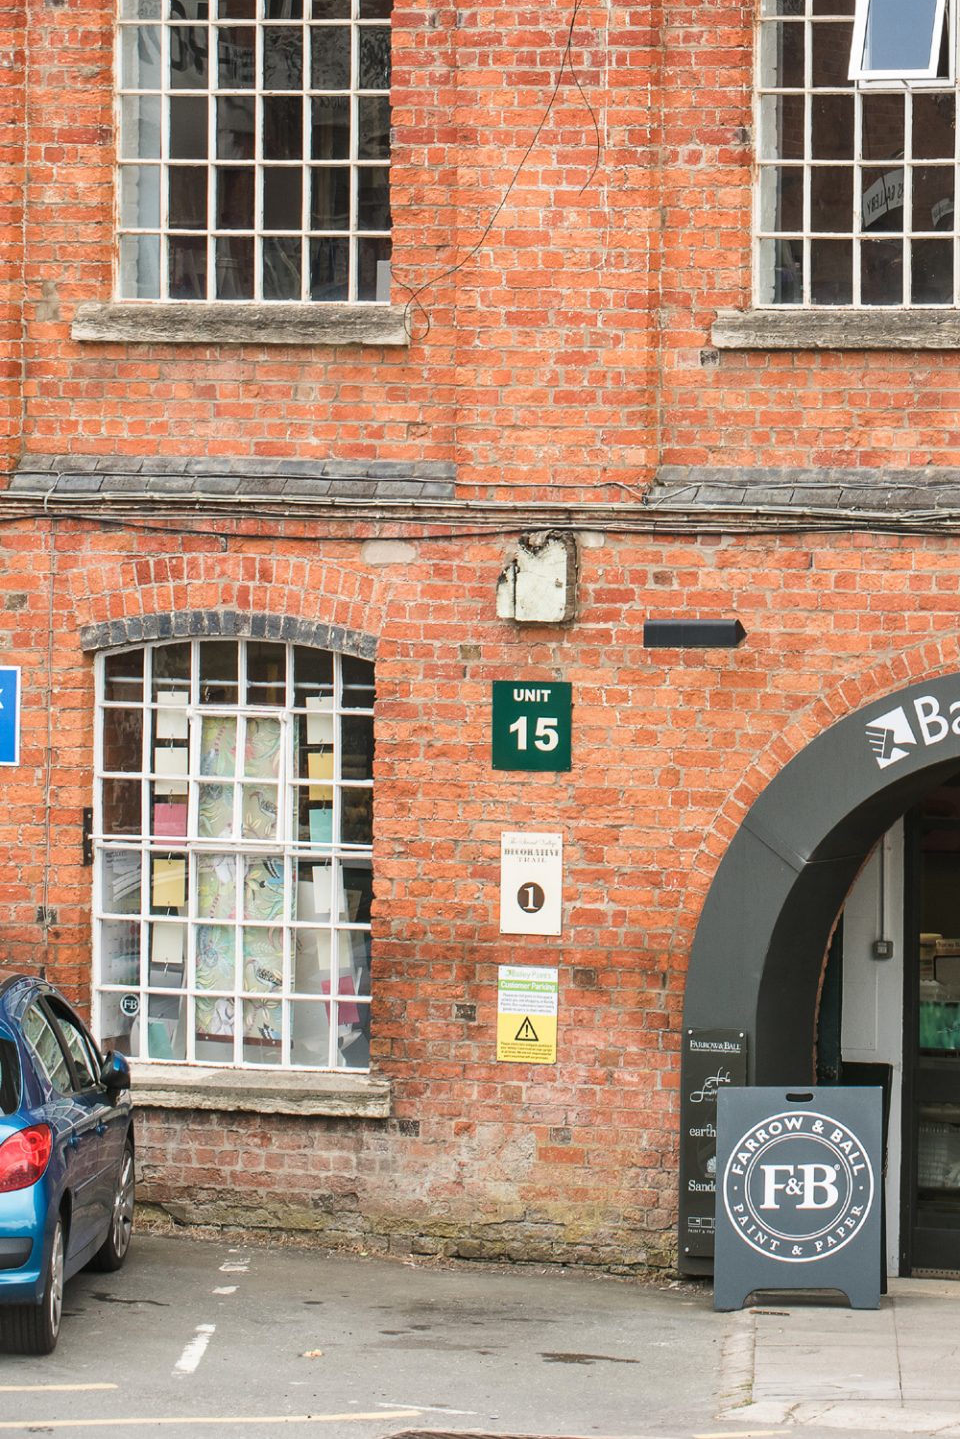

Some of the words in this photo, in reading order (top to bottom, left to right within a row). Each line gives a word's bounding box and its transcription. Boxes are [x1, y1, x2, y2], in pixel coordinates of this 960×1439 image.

[513, 689, 551, 702] UNIT
[509, 716, 559, 751] 15
[523, 886, 539, 910] 1
[500, 980, 531, 989] Customer
[531, 981, 556, 992] Parking
[732, 1116, 804, 1175] FARROW
[812, 1119, 825, 1134] &
[830, 1128, 866, 1176] BALL
[760, 1163, 839, 1210] F&B
[733, 1203, 781, 1251] PAINT
[791, 1245, 803, 1255] &
[814, 1204, 864, 1252] PAPER
